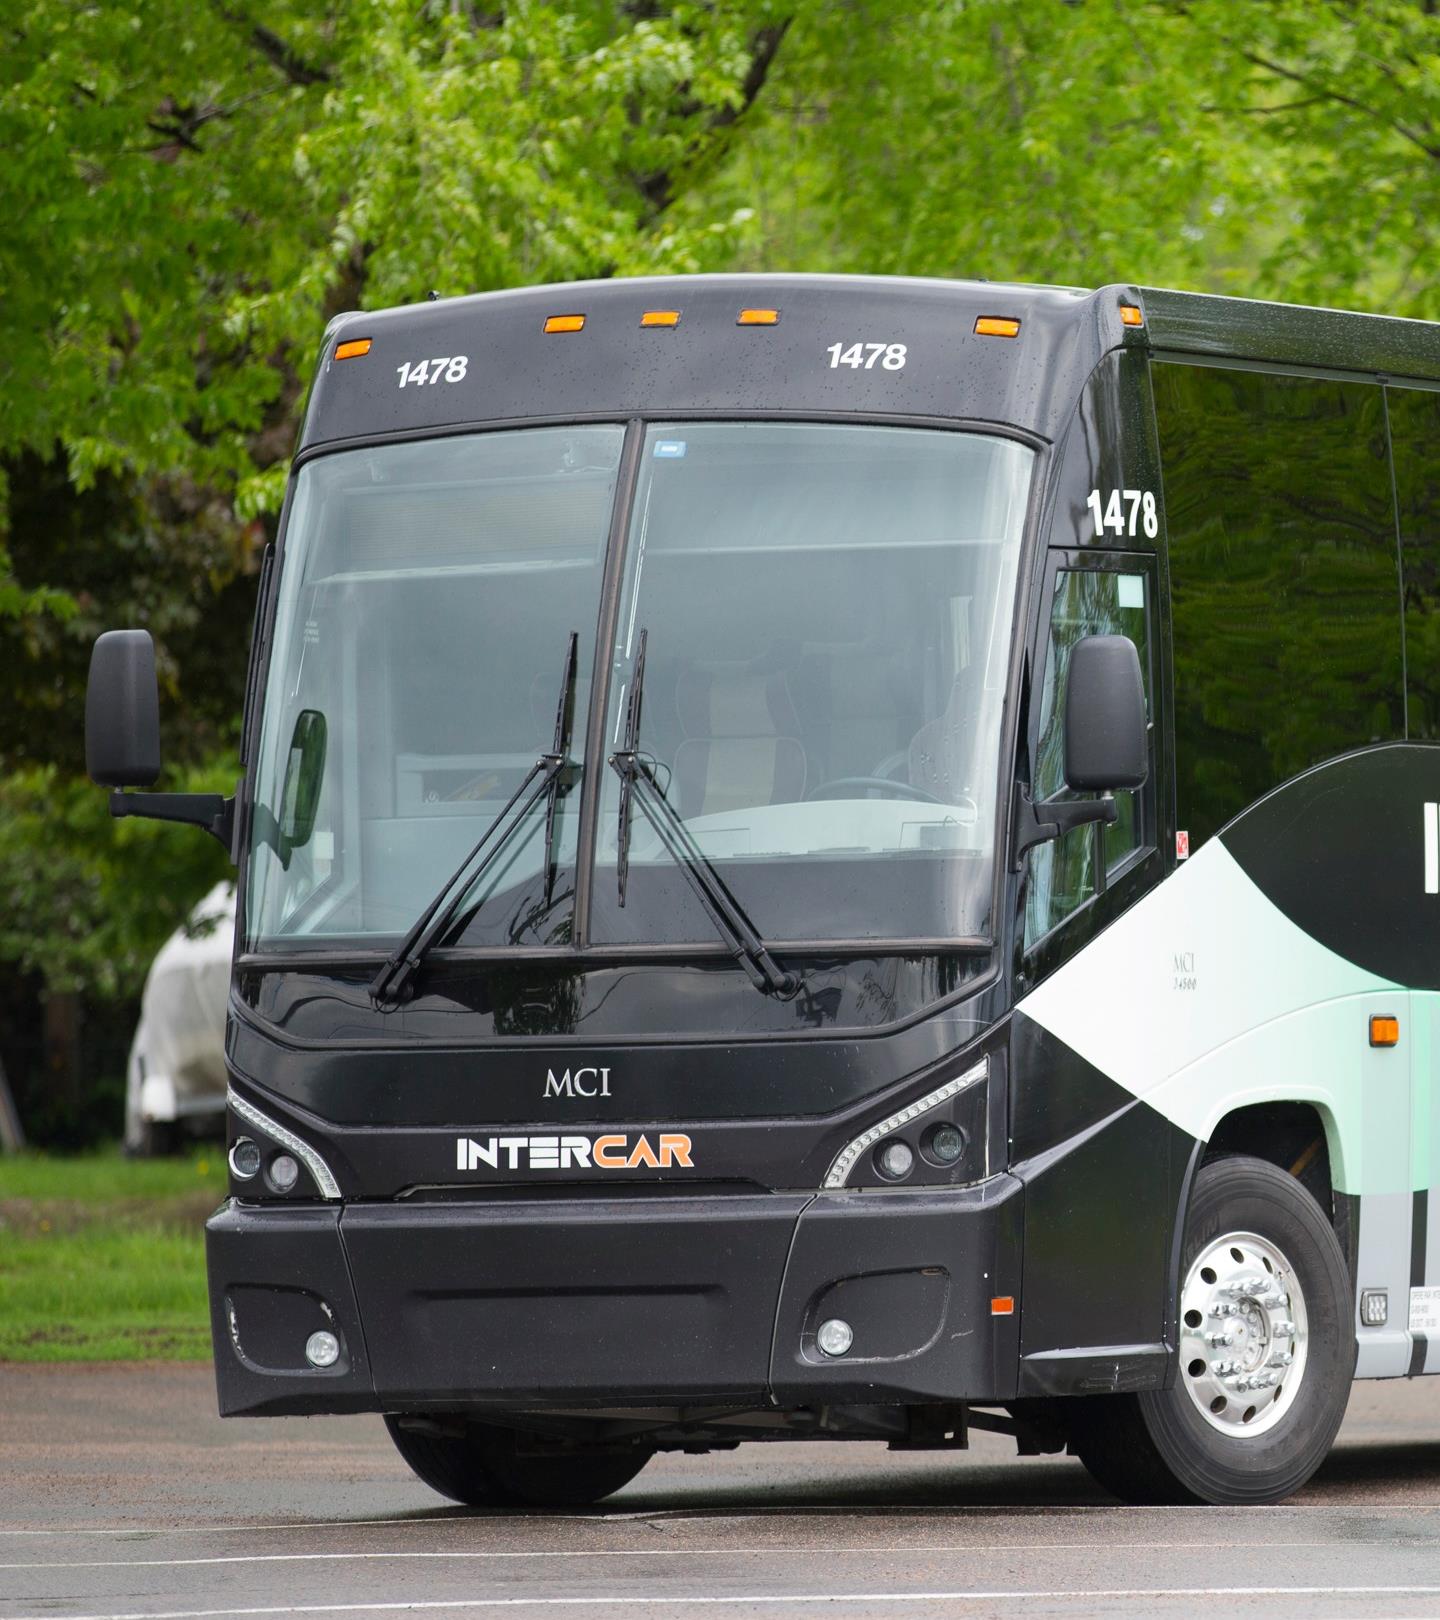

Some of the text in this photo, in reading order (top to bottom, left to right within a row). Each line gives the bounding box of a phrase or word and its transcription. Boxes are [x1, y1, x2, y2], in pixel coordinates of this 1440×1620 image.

[397, 355, 468, 389] 1478
[827, 342, 907, 370] 1478
[1087, 489, 1158, 539] 1478
[542, 1068, 612, 1098] MCI
[456, 1133, 695, 1170] INTERCAR
